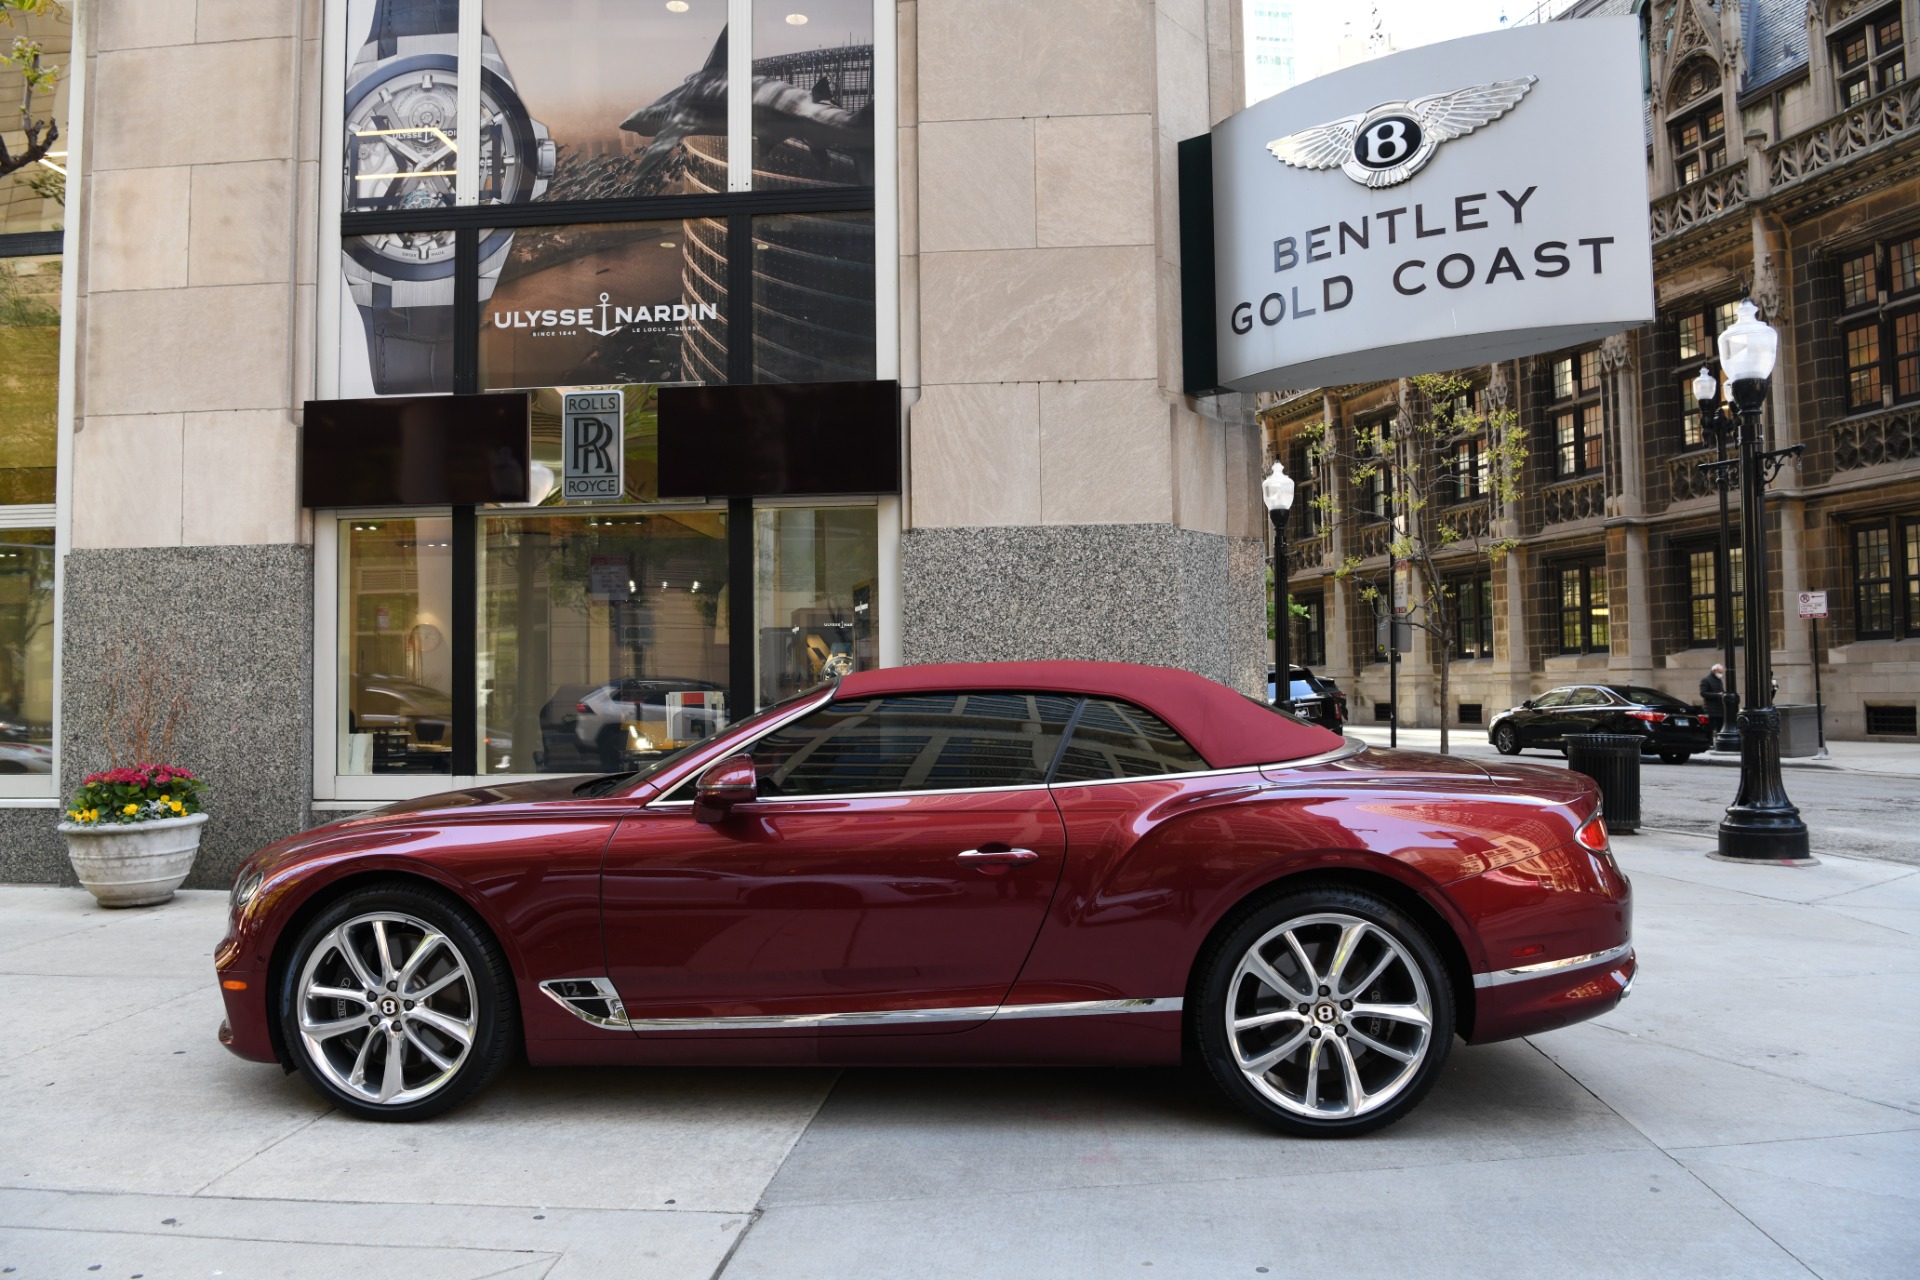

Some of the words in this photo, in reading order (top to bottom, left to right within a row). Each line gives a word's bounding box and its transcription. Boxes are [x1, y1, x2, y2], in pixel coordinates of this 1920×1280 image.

[1365, 120, 1408, 164] B
[1273, 185, 1538, 273] BENTLEY
[1231, 274, 1354, 336] GOLD
[1392, 236, 1615, 296] COAST
[494, 308, 594, 328] ULYSSE
[615, 303, 717, 324] NARDIN
[568, 397, 616, 411] ROLLS
[573, 416, 614, 474] RR
[568, 480, 616, 493] ROYCE
[560, 982, 581, 996] 12
